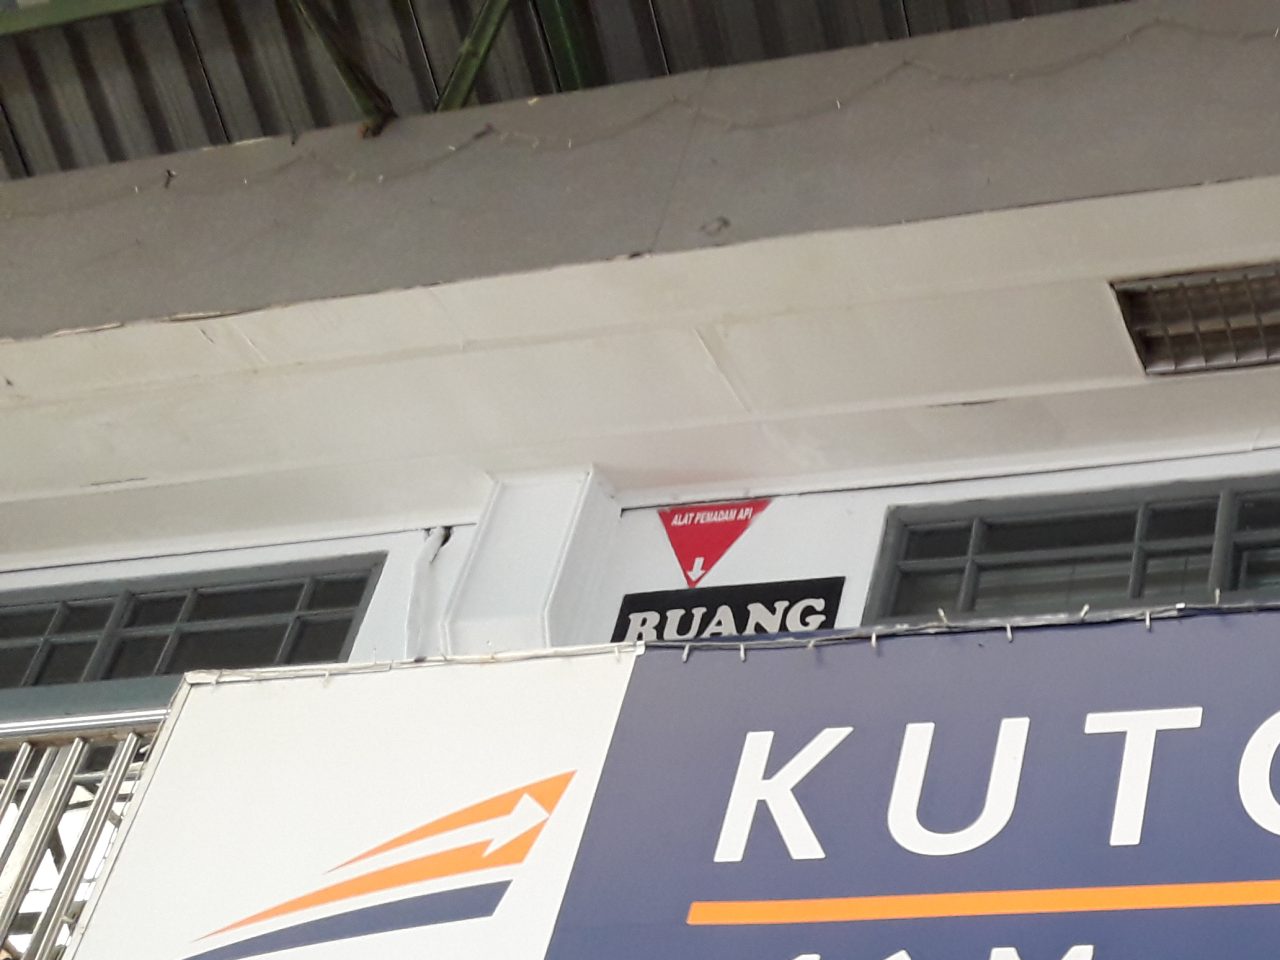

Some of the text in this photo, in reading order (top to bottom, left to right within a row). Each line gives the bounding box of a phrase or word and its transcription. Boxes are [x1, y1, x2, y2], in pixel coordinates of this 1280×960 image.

[671, 508, 753, 525] ALAT PEMADAM API
[623, 598, 826, 642] RUANG
